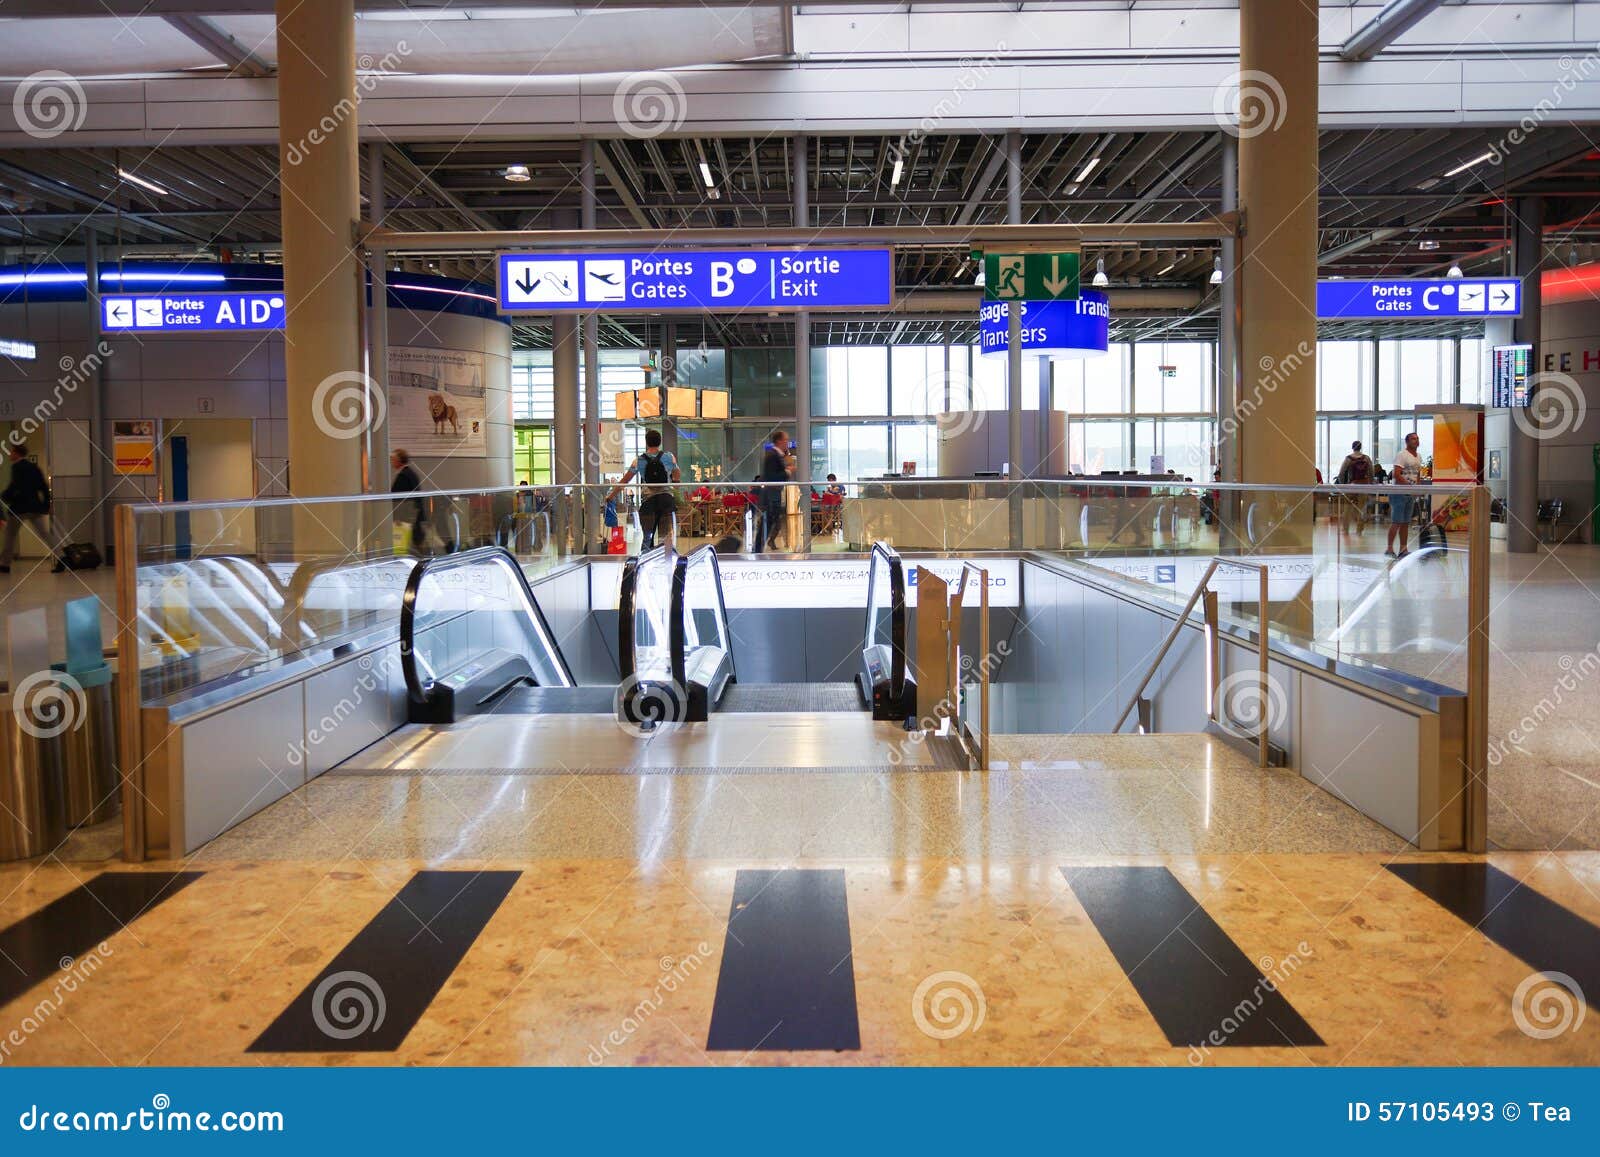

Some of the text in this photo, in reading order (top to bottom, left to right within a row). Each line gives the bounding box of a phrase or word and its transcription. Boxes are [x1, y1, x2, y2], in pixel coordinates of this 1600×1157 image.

[631, 256, 840, 298] Portes B Sortie
[631, 278, 818, 299] Gates Exit
[1372, 285, 1440, 311] Portes C
[165, 299, 205, 310] Portes
[1375, 299, 1412, 312] Gates
[165, 313, 201, 325] Gates
[982, 327, 1047, 347] Transers
